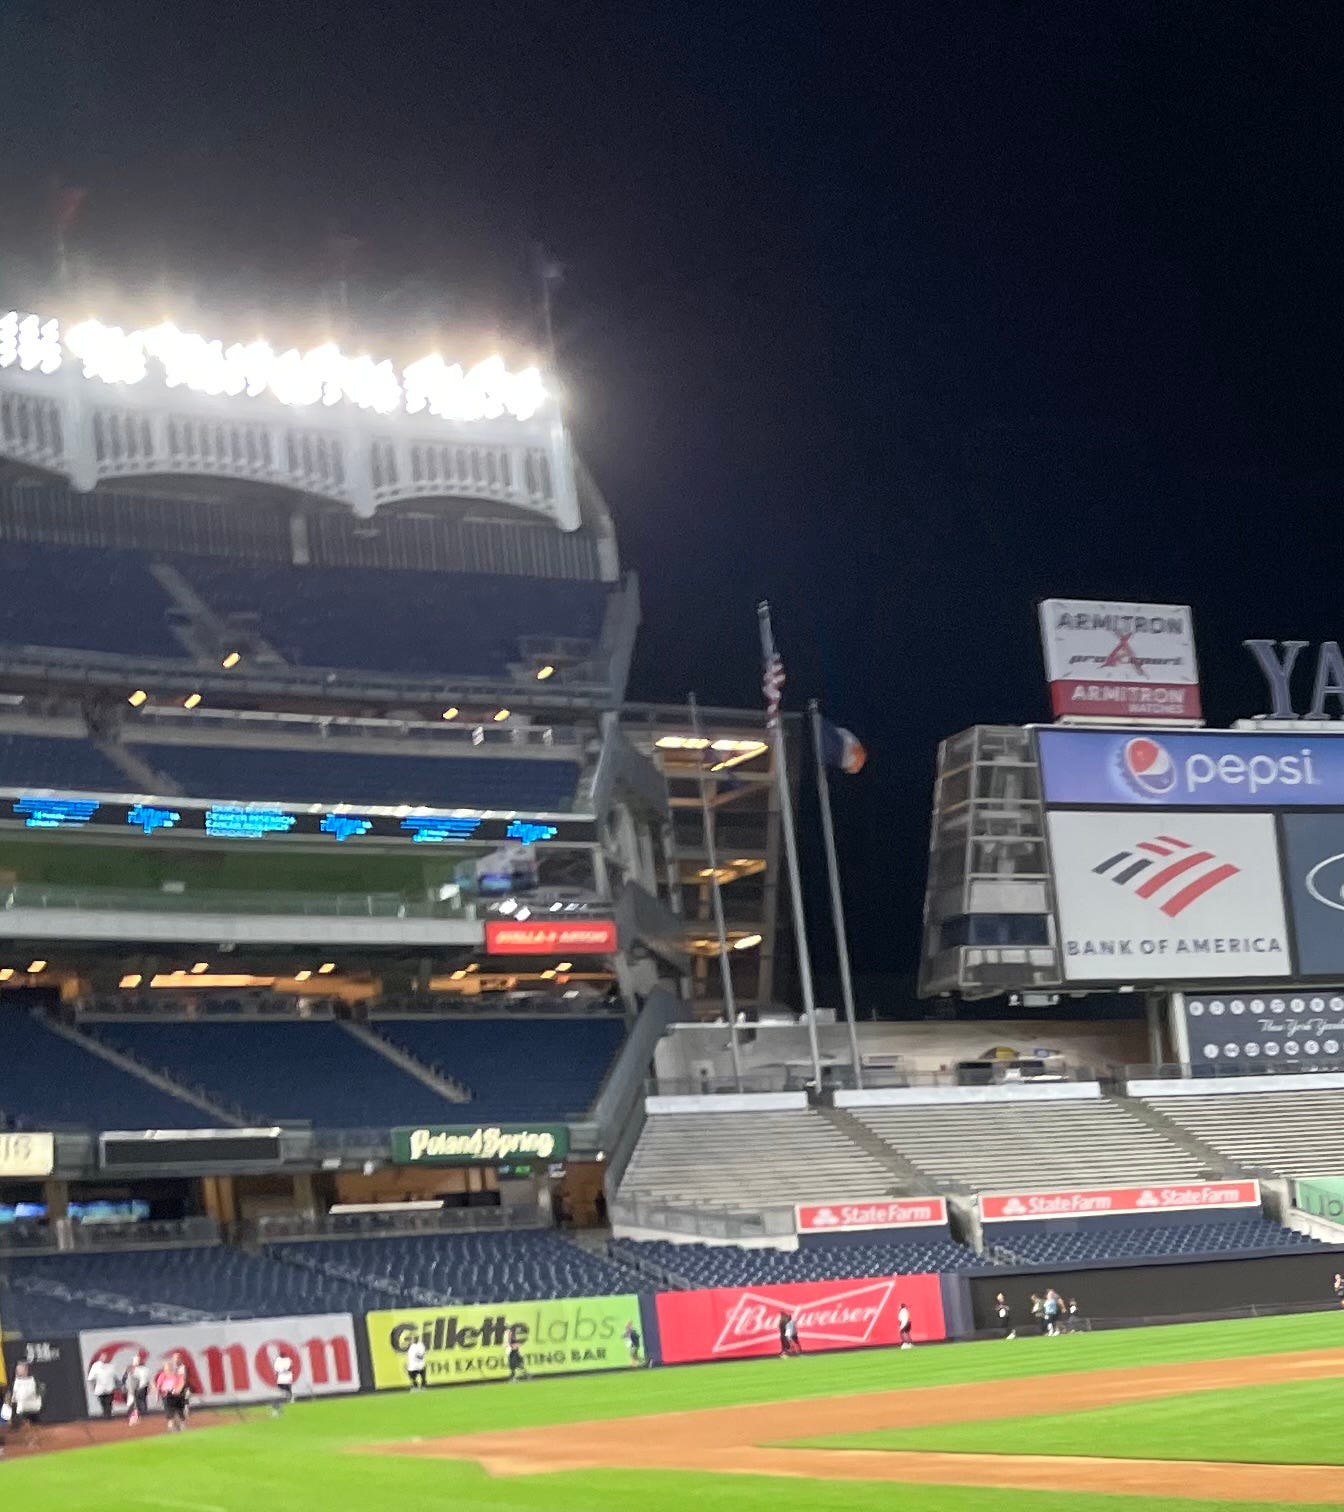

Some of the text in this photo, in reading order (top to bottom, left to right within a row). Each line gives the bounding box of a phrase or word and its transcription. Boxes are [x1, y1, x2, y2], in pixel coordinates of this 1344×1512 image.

[1056, 612, 1183, 634] ARMITRON
[1072, 685, 1185, 703] ARMITRON
[1186, 749, 1312, 793] pepsi
[1067, 936, 1282, 956] BANK OF AMERICA
[411, 1127, 555, 1160] Poland Spring
[1028, 1186, 1239, 1215] State Farm State Farm
[841, 1203, 931, 1226] State Farm
[391, 1307, 614, 1352] Gillette Labs
